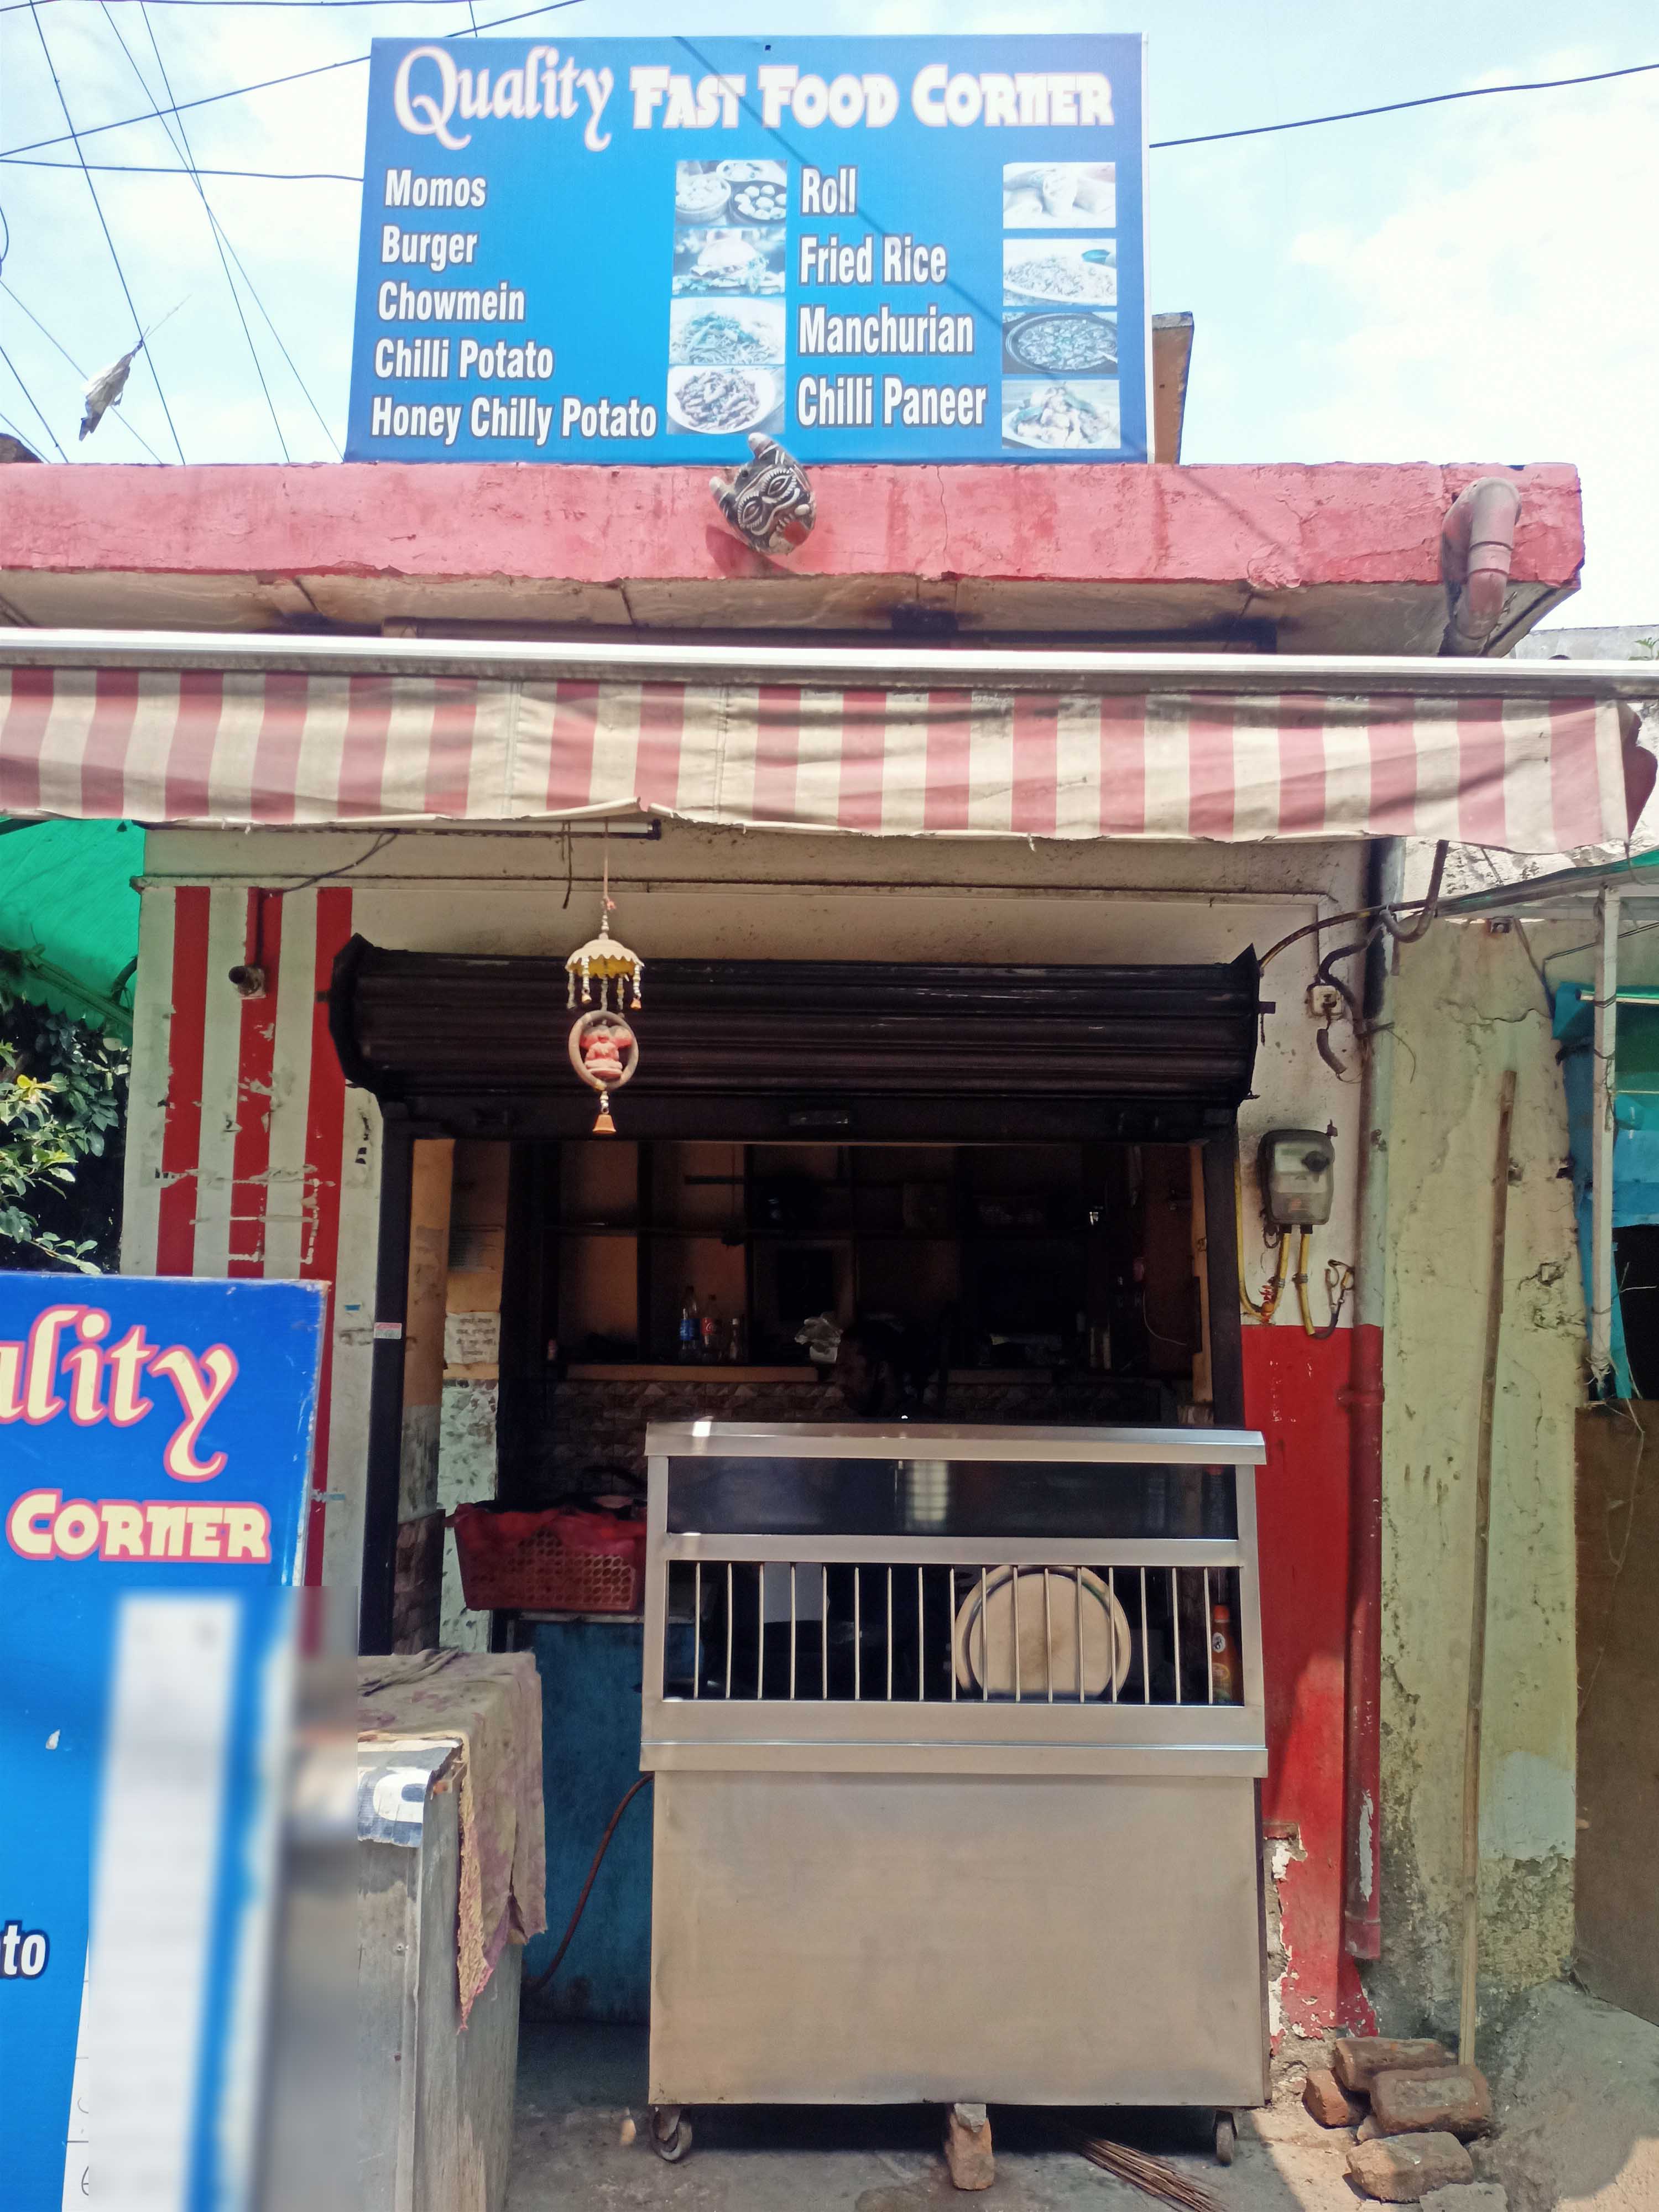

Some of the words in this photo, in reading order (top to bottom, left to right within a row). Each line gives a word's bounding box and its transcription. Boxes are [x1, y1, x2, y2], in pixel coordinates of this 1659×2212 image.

[393, 44, 615, 152] Quality
[629, 65, 747, 129] FAST
[757, 64, 899, 128] FOOD
[911, 64, 1115, 127] CORNER
[384, 168, 487, 207] Momos
[801, 166, 857, 215] Roll
[380, 225, 478, 272] Burger
[800, 234, 873, 285] Fried
[883, 233, 948, 283] Rice
[377, 281, 526, 321] Chowmein
[797, 304, 975, 356] Manchurian
[373, 337, 450, 379] Chilli
[458, 338, 555, 379] Potato
[370, 395, 463, 446] Honey
[470, 397, 554, 446] Chilly
[560, 395, 658, 438] Potato
[797, 375, 874, 427] Chilli
[883, 376, 988, 427] Paneer
[7, 1488, 271, 1564] CORNER
